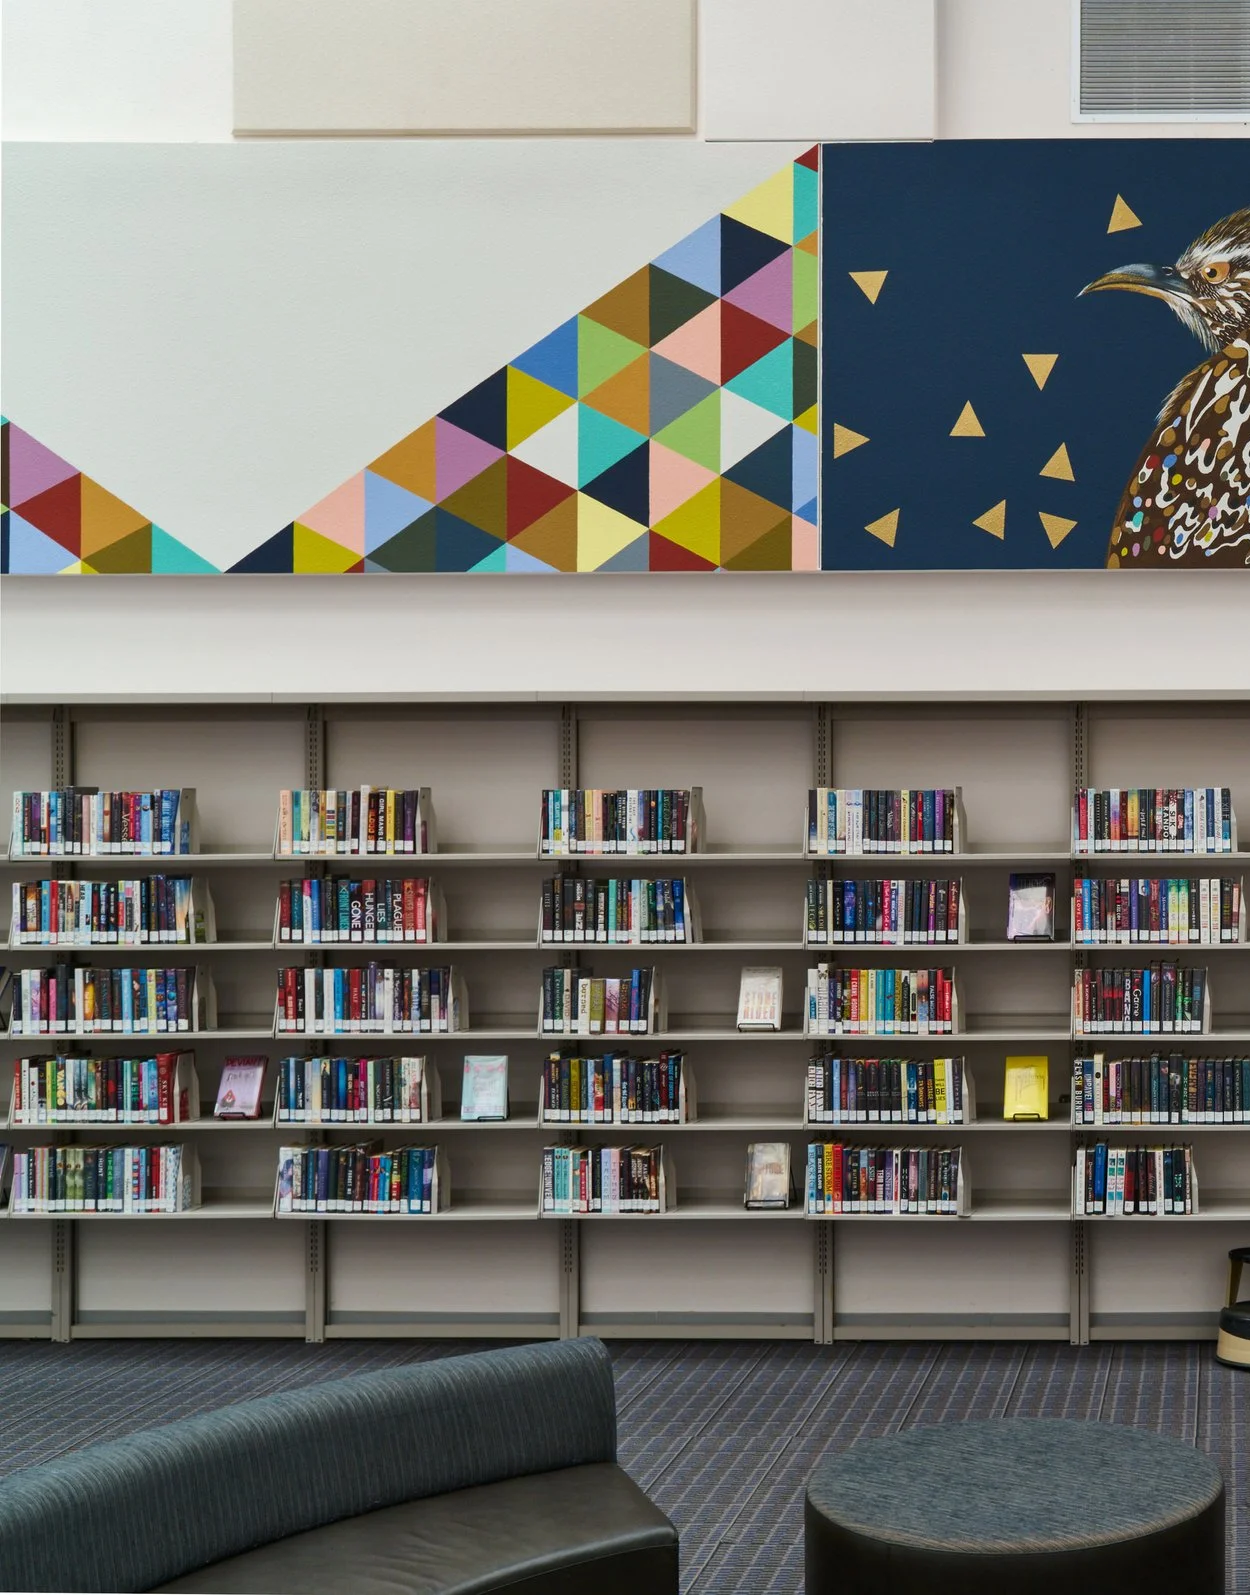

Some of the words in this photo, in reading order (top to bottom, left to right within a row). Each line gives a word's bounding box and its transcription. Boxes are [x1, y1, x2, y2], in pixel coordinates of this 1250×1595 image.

[377, 798, 385, 814] GIRL
[121, 813, 130, 842] Vesse
[377, 815, 385, 836] MANS
[340, 891, 349, 912] FRONT
[365, 892, 374, 930] HUNGE
[377, 903, 386, 923] LIES
[393, 893, 402, 932] PLAGUE
[340, 912, 349, 931] LINES
[351, 900, 361, 929] GONE
[580, 983, 588, 1014] burned
[1133, 988, 1142, 1017] Game
[1074, 1060, 1083, 1086] FLASH
[56, 1069, 66, 1106] VANGO
[1084, 1073, 1093, 1101] UNRAVEL
[1074, 1090, 1083, 1112] BURN
[545, 1158, 553, 1174] EDGE
[876, 1169, 884, 1183] TEAM
[545, 1176, 553, 1200] UNIVER
